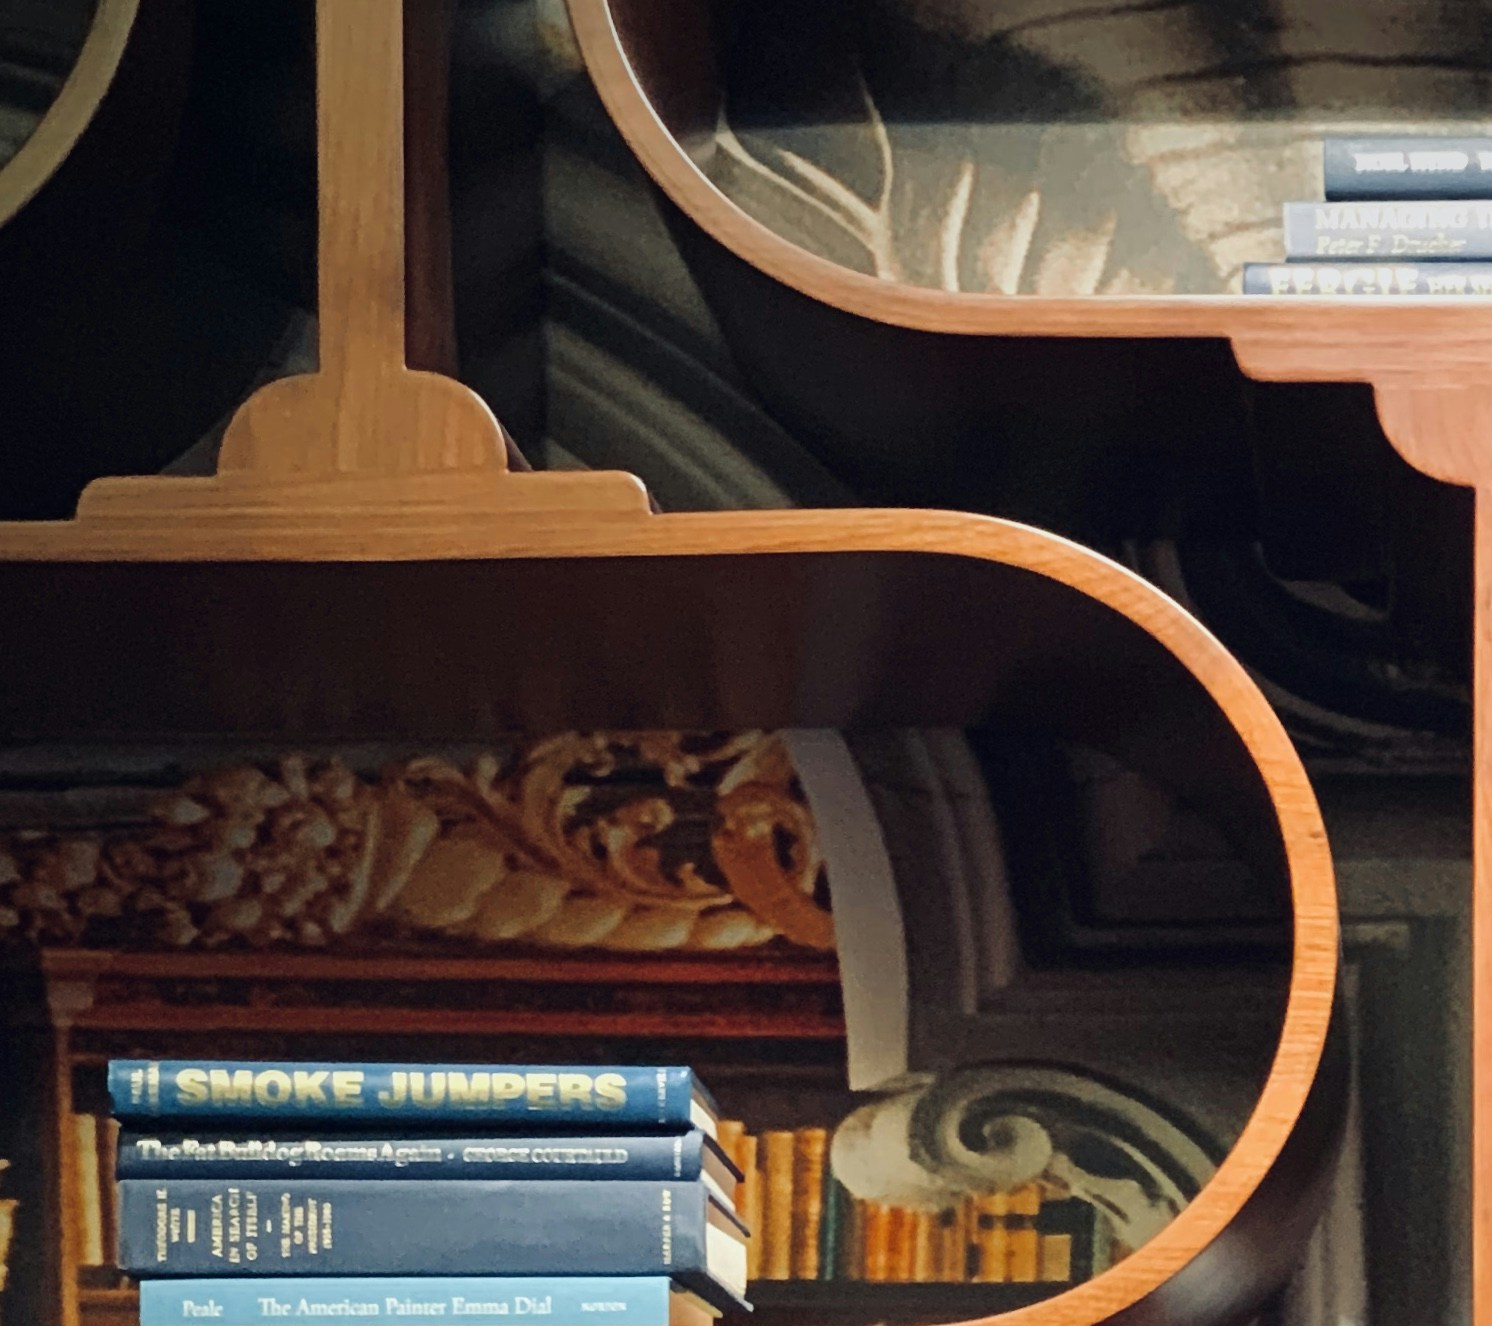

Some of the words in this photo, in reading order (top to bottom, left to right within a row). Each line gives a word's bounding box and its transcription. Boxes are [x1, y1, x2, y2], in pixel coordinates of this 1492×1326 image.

[1315, 206, 1469, 230] MANAGING
[174, 1068, 365, 1107] SMOKE
[378, 1071, 628, 1111] JUMPERS
[136, 1139, 180, 1161] The
[380, 1140, 442, 1167] Again
[211, 1194, 223, 1257] AMERICA
[228, 1188, 240, 1242] SEARCH
[228, 1247, 240, 1263] IN
[246, 1242, 258, 1261] OF
[182, 1300, 224, 1317] Peale
[258, 1297, 291, 1316] The
[298, 1298, 379, 1317] American
[385, 1297, 446, 1316] Painter
[452, 1297, 509, 1315] Emma
[514, 1296, 552, 1315] Dial
